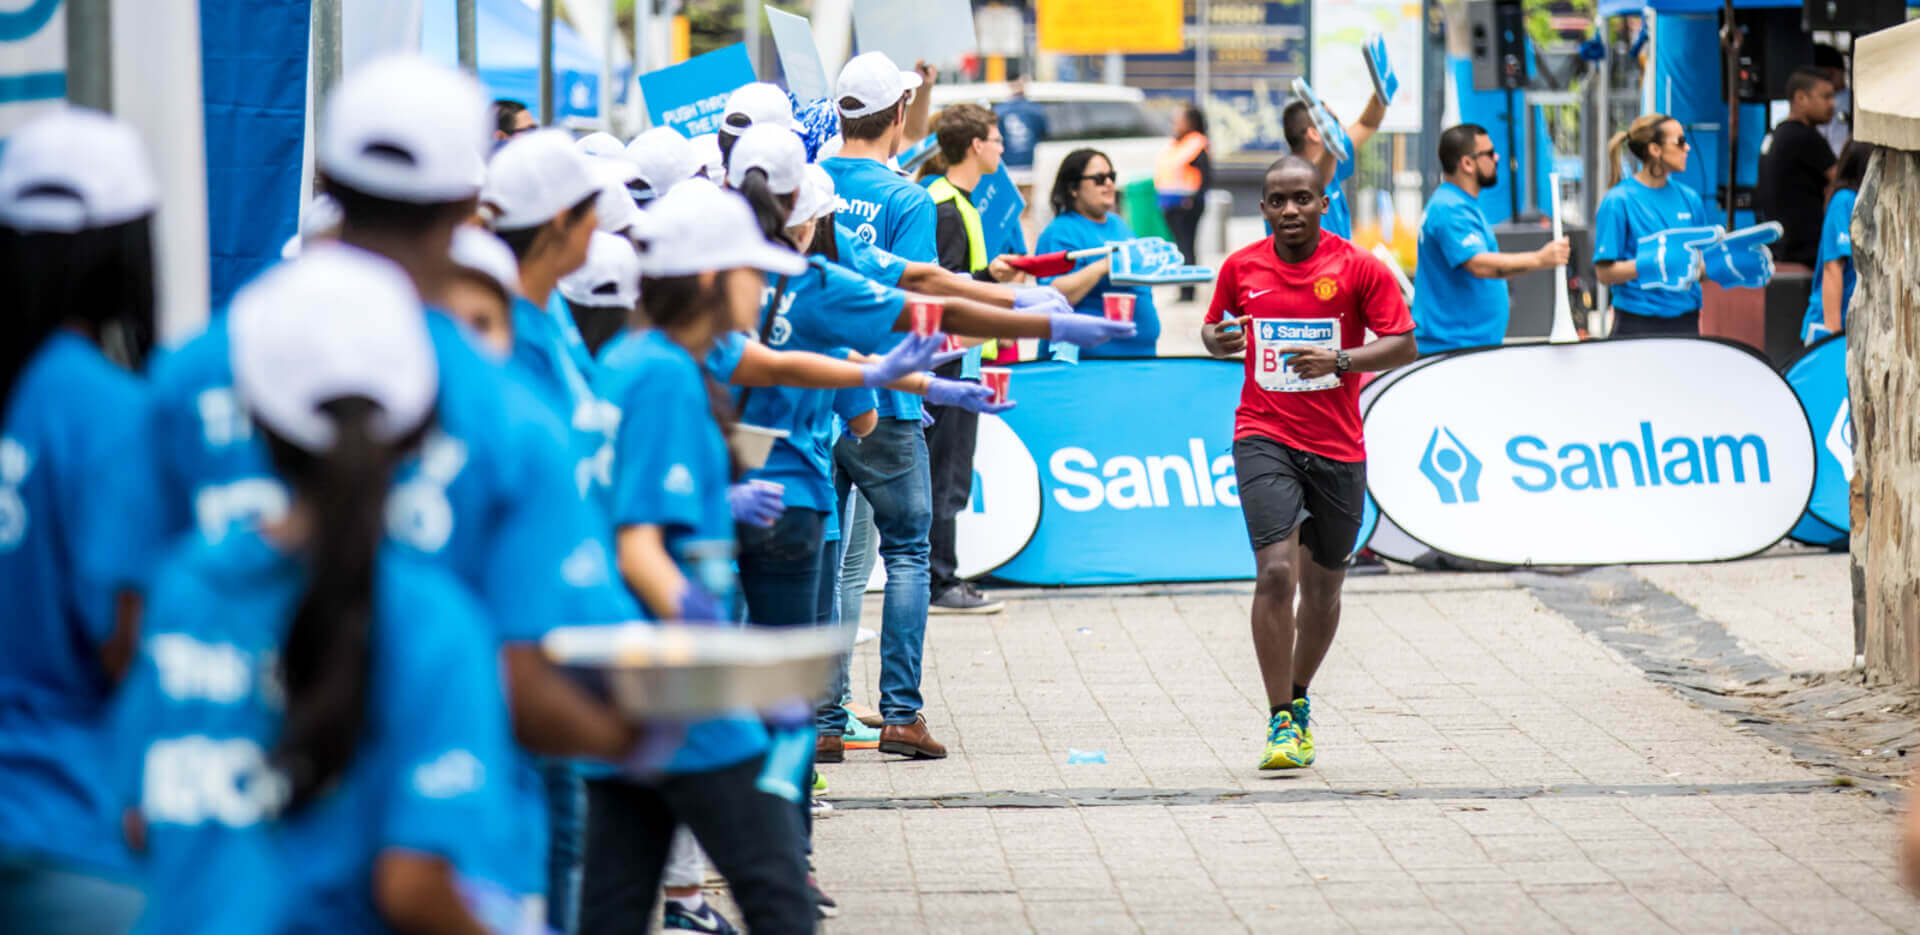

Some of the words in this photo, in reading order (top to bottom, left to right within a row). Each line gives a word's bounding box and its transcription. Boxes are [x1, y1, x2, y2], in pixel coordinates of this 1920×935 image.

[663, 104, 698, 126] PUSH
[1277, 325, 1331, 338] Sanlam
[1049, 438, 1240, 511] Sanla
[1505, 421, 1770, 493] Sanlam
